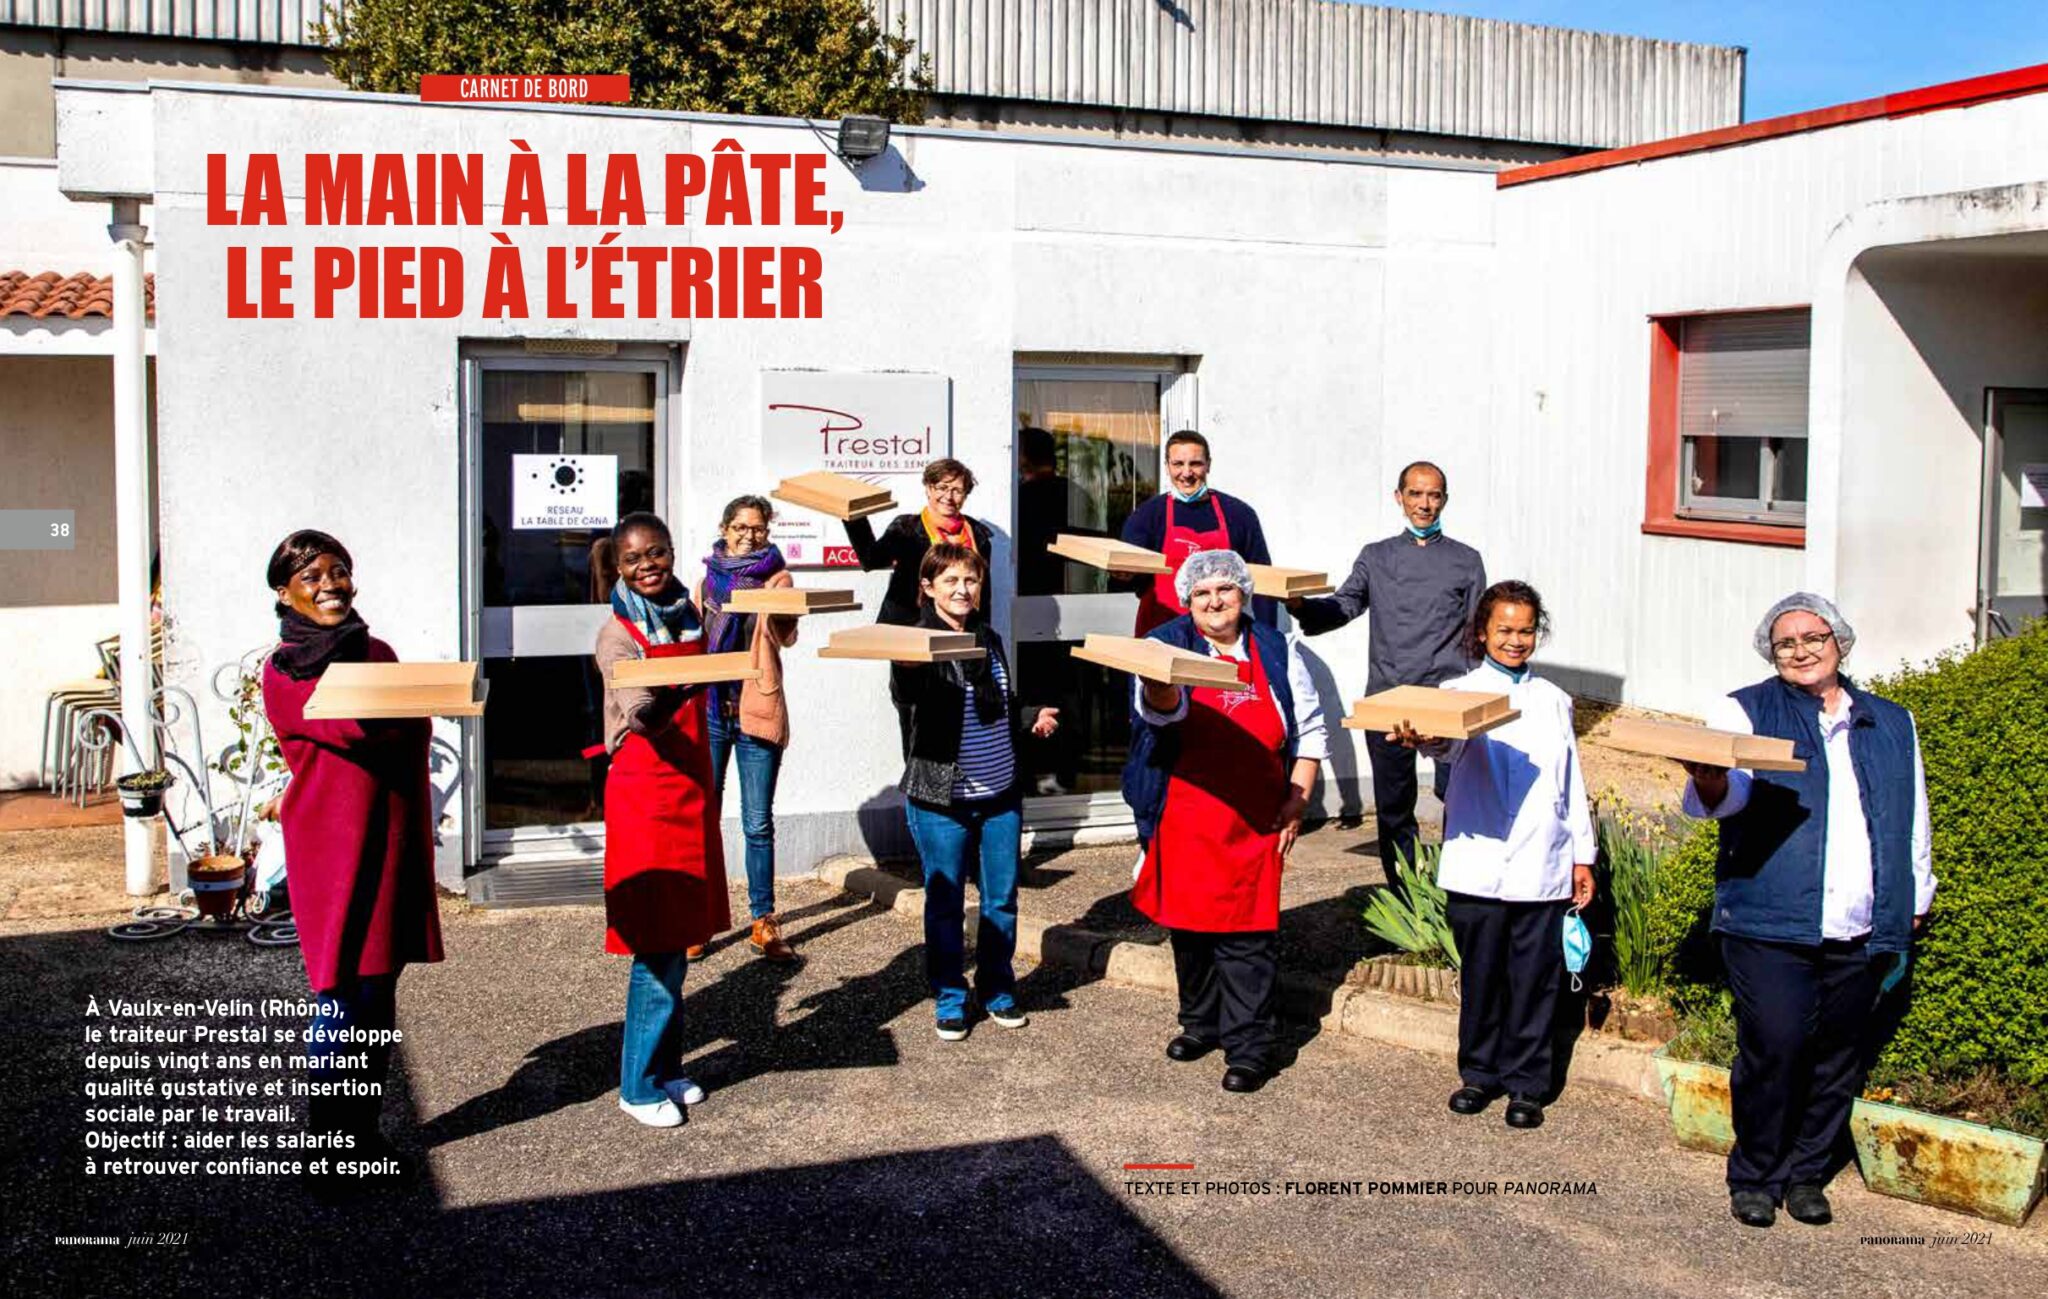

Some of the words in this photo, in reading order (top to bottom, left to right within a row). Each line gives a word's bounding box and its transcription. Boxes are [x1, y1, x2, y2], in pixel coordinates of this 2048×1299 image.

[769, 404, 931, 455] Prestal
[825, 460, 873, 469] TRAITEUR
[880, 460, 899, 469] DES
[521, 517, 533, 526] LA
[537, 517, 564, 526] TABLE
[568, 517, 579, 526] DE
[582, 517, 608, 526] CANA
